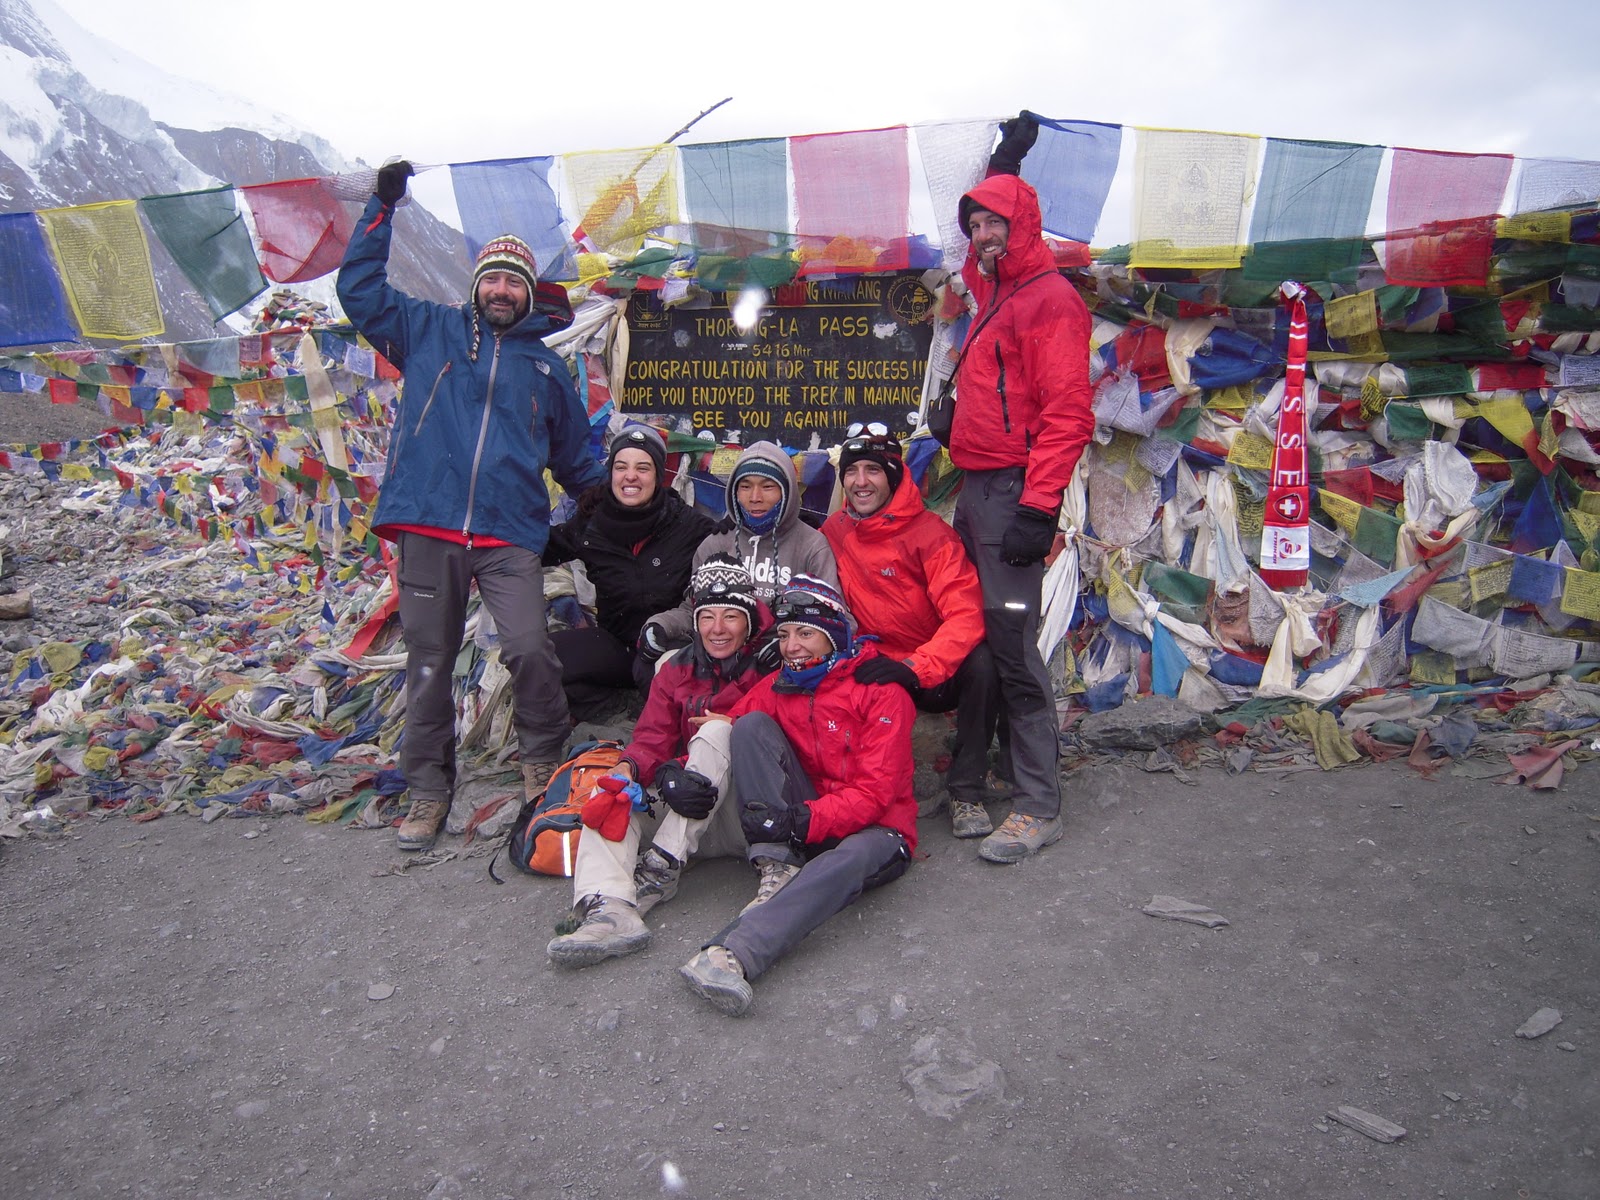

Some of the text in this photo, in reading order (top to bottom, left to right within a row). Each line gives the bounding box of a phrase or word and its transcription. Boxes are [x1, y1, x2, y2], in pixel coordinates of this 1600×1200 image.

[819, 316, 869, 337] PASS
[628, 360, 768, 380] CONGRATULATION
[776, 360, 804, 380] FOR
[813, 360, 840, 380] THE
[622, 386, 921, 407] HOPE YOU ENJOYED THE TREK IN MANANG
[692, 410, 726, 428] SEE
[738, 410, 771, 428] YOU
